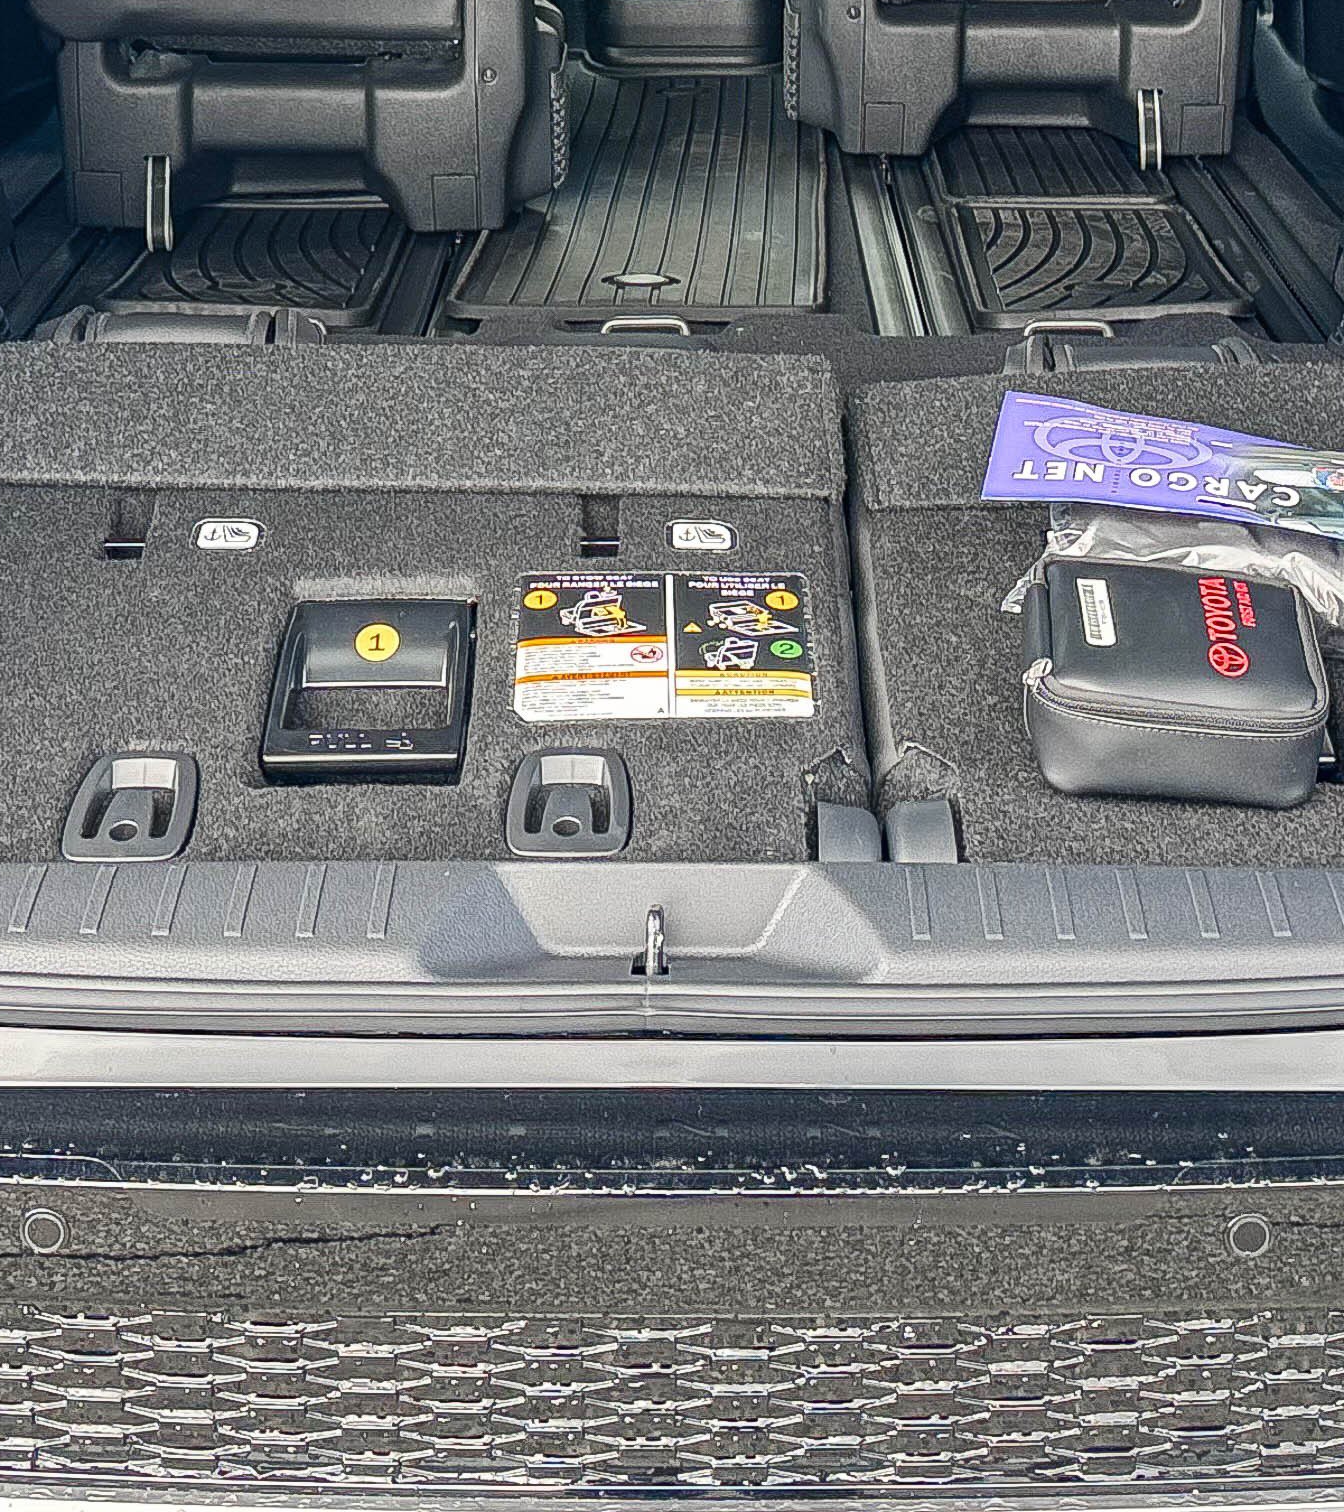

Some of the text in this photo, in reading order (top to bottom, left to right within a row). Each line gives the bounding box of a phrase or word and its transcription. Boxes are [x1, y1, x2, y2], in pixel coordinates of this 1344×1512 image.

[1013, 459, 1105, 484] NET
[1129, 467, 1301, 508] CARGO
[1198, 578, 1237, 641] TOYOTA
[367, 633, 386, 652] 1
[778, 643, 795, 655] 2
